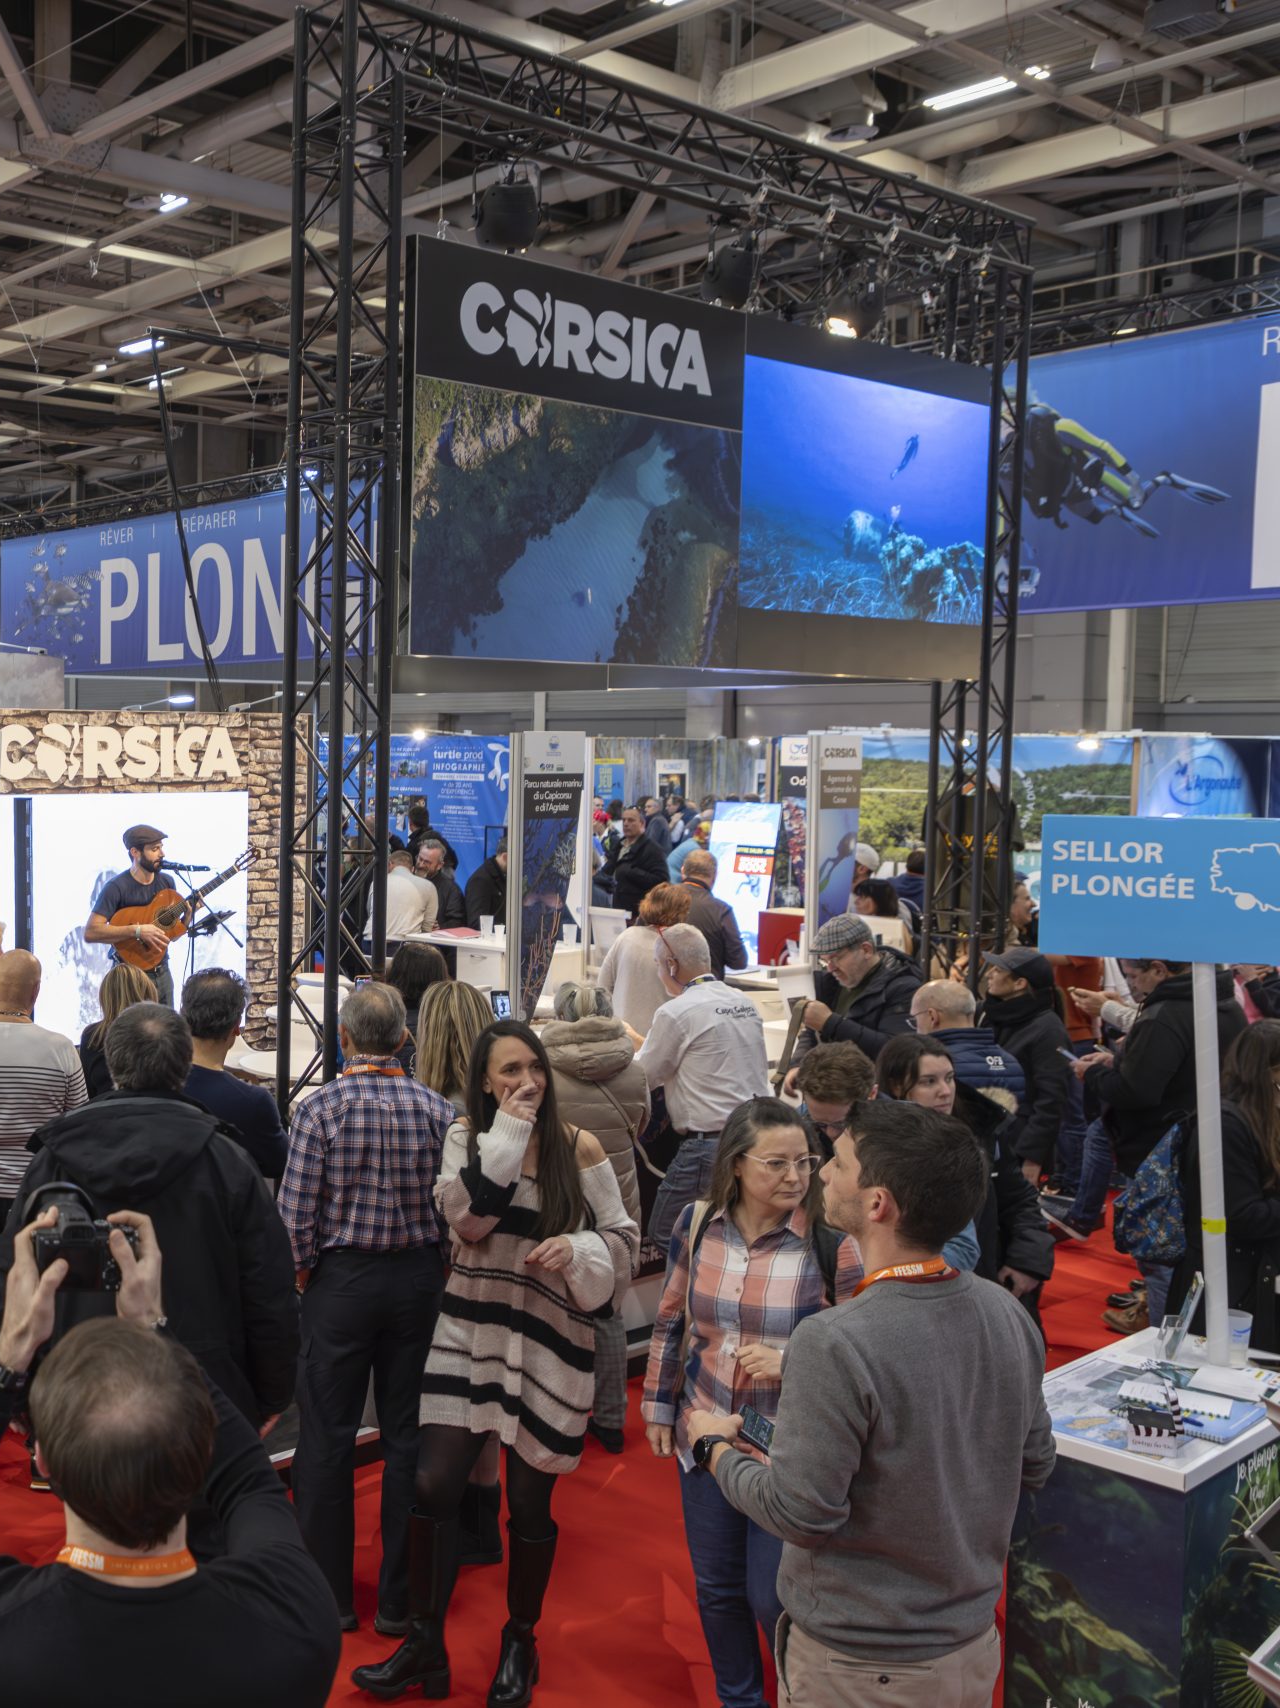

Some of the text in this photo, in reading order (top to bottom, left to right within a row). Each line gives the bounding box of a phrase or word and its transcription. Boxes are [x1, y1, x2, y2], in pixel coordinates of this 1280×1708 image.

[459, 281, 712, 396] CORSICA
[100, 526, 134, 547] RÊVER
[0, 721, 242, 784] CORSICA
[433, 750, 483, 761] turtle prod
[824, 747, 857, 759] CORSICA
[433, 762, 486, 772] INFOGRAPHIE
[524, 779, 583, 788] Parcu naturale marinu
[544, 791, 572, 802] Capicorsu
[1052, 839, 1163, 864] SELLOR
[1051, 873, 1195, 900] PLONGÉE
[892, 1263, 924, 1277] FFESSM
